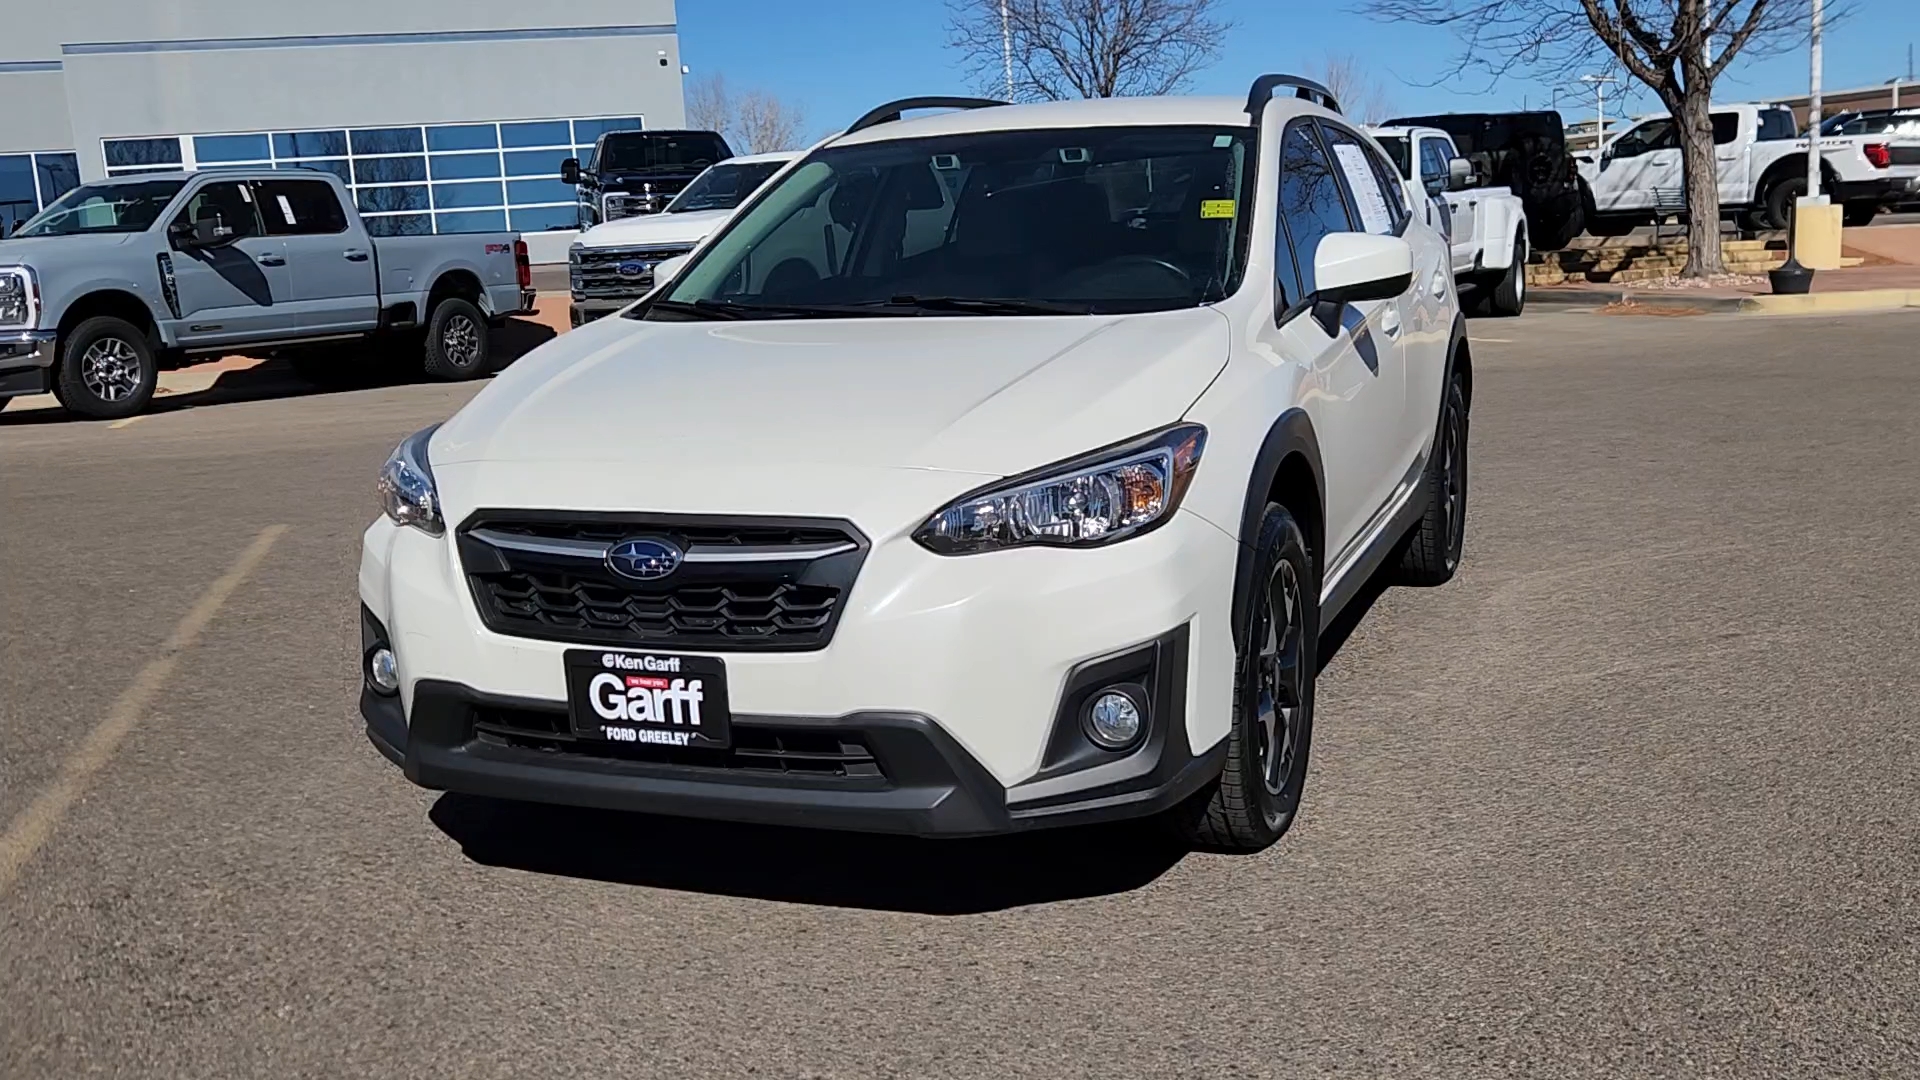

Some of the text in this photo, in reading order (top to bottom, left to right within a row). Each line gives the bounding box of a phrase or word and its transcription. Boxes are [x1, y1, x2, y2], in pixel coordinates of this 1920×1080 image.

[589, 672, 703, 726] Garff
[606, 726, 690, 746] FORD GREELEY
